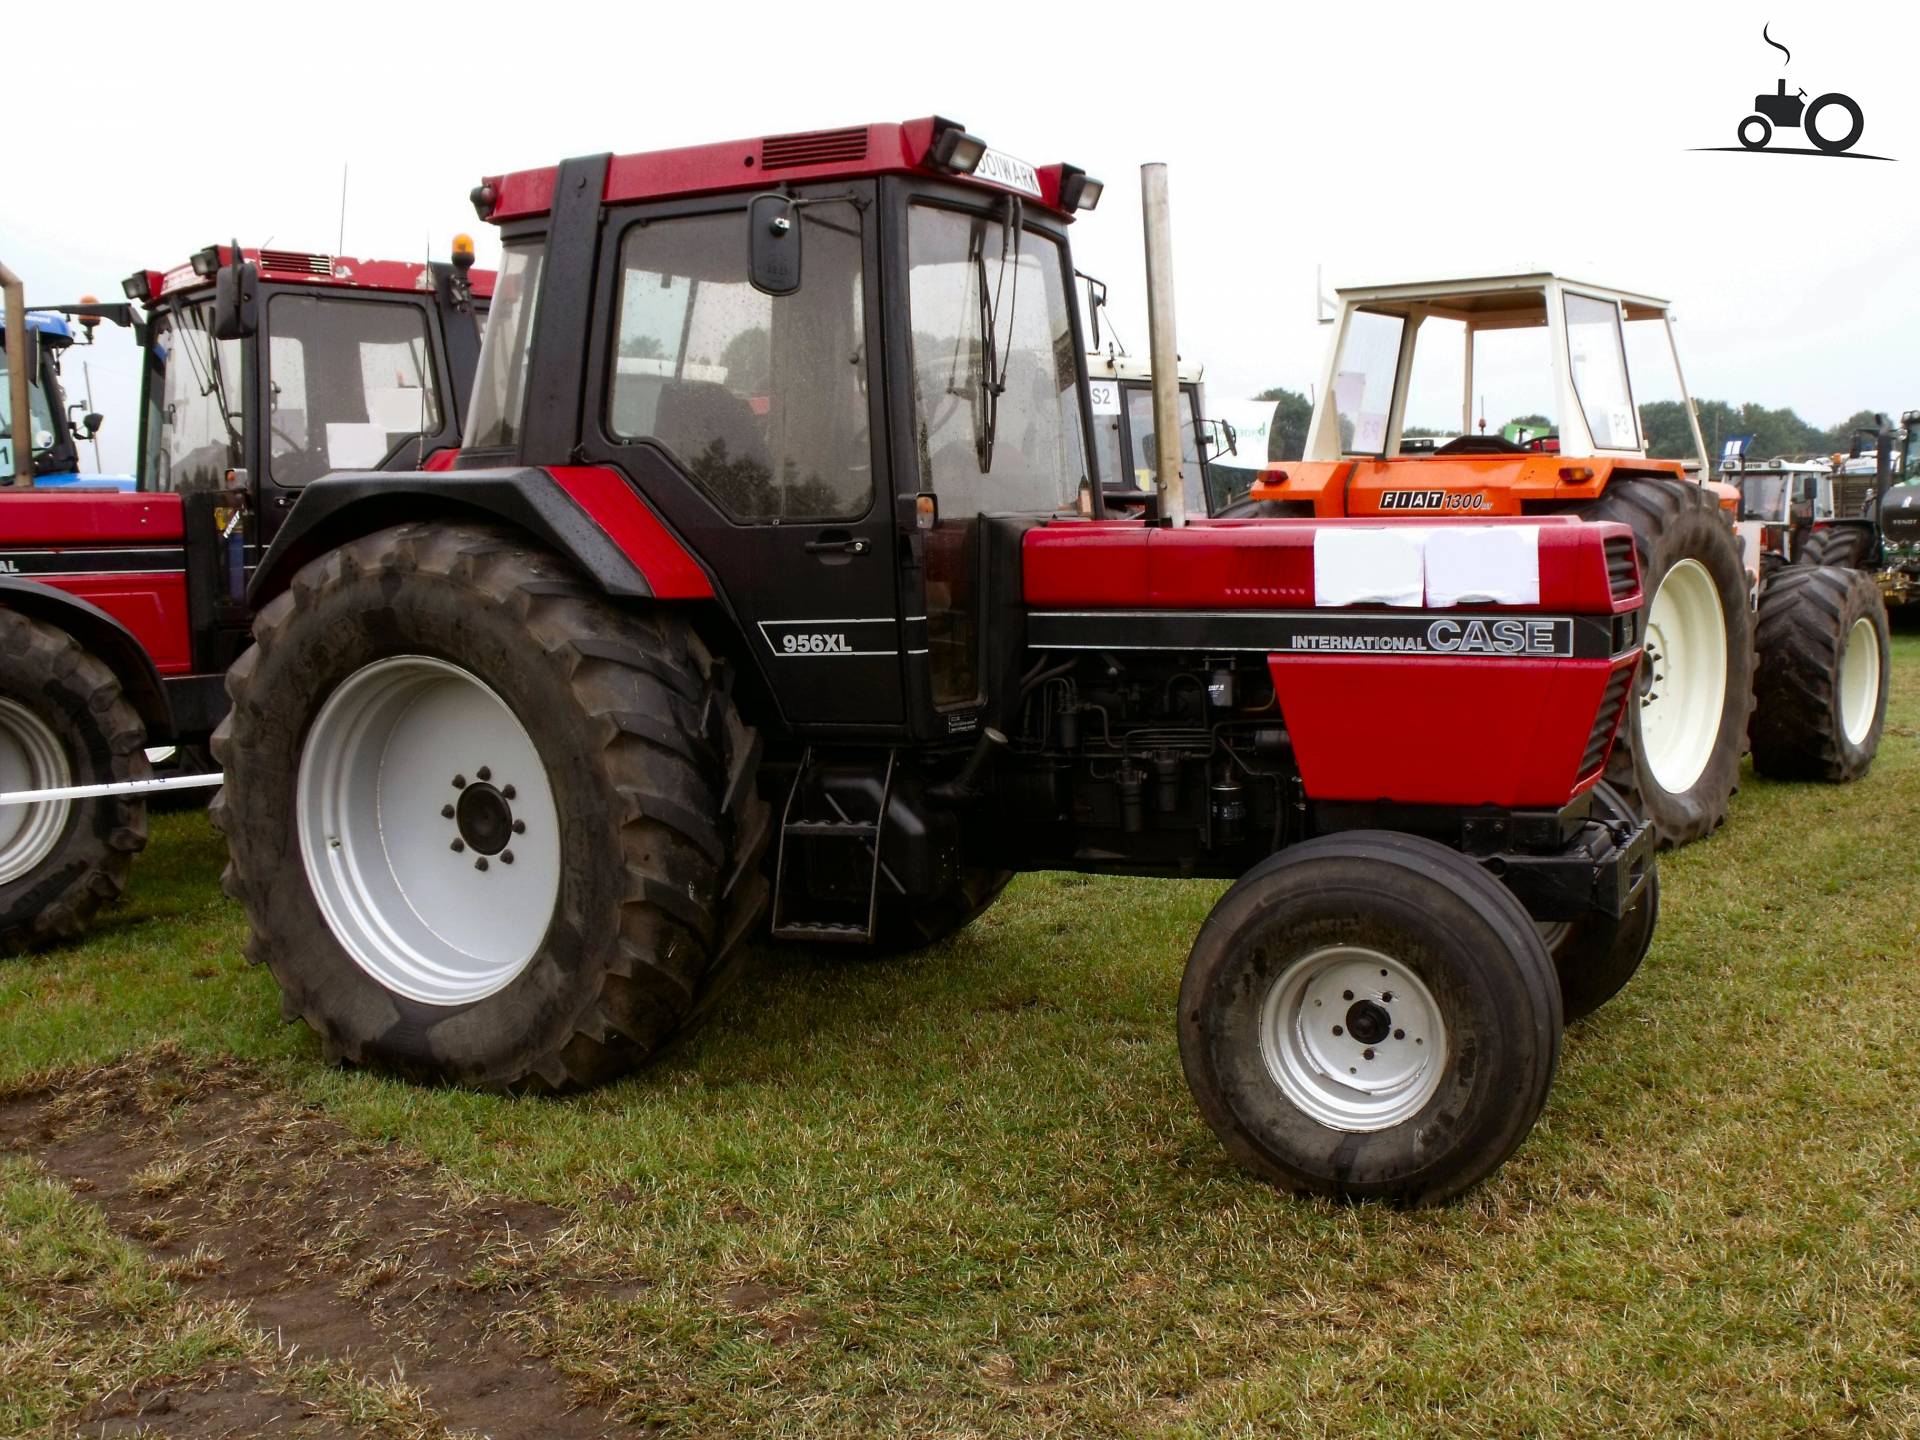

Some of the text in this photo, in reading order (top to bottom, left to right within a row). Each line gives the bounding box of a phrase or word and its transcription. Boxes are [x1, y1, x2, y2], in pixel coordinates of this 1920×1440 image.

[1092, 388, 1111, 405] S2
[1613, 413, 1630, 435] P3
[1382, 492, 1443, 508] FIAT
[1446, 494, 1483, 509] 1300
[782, 634, 852, 652] 956XL
[1291, 619, 1555, 653] INTERNATIONAL CASE
